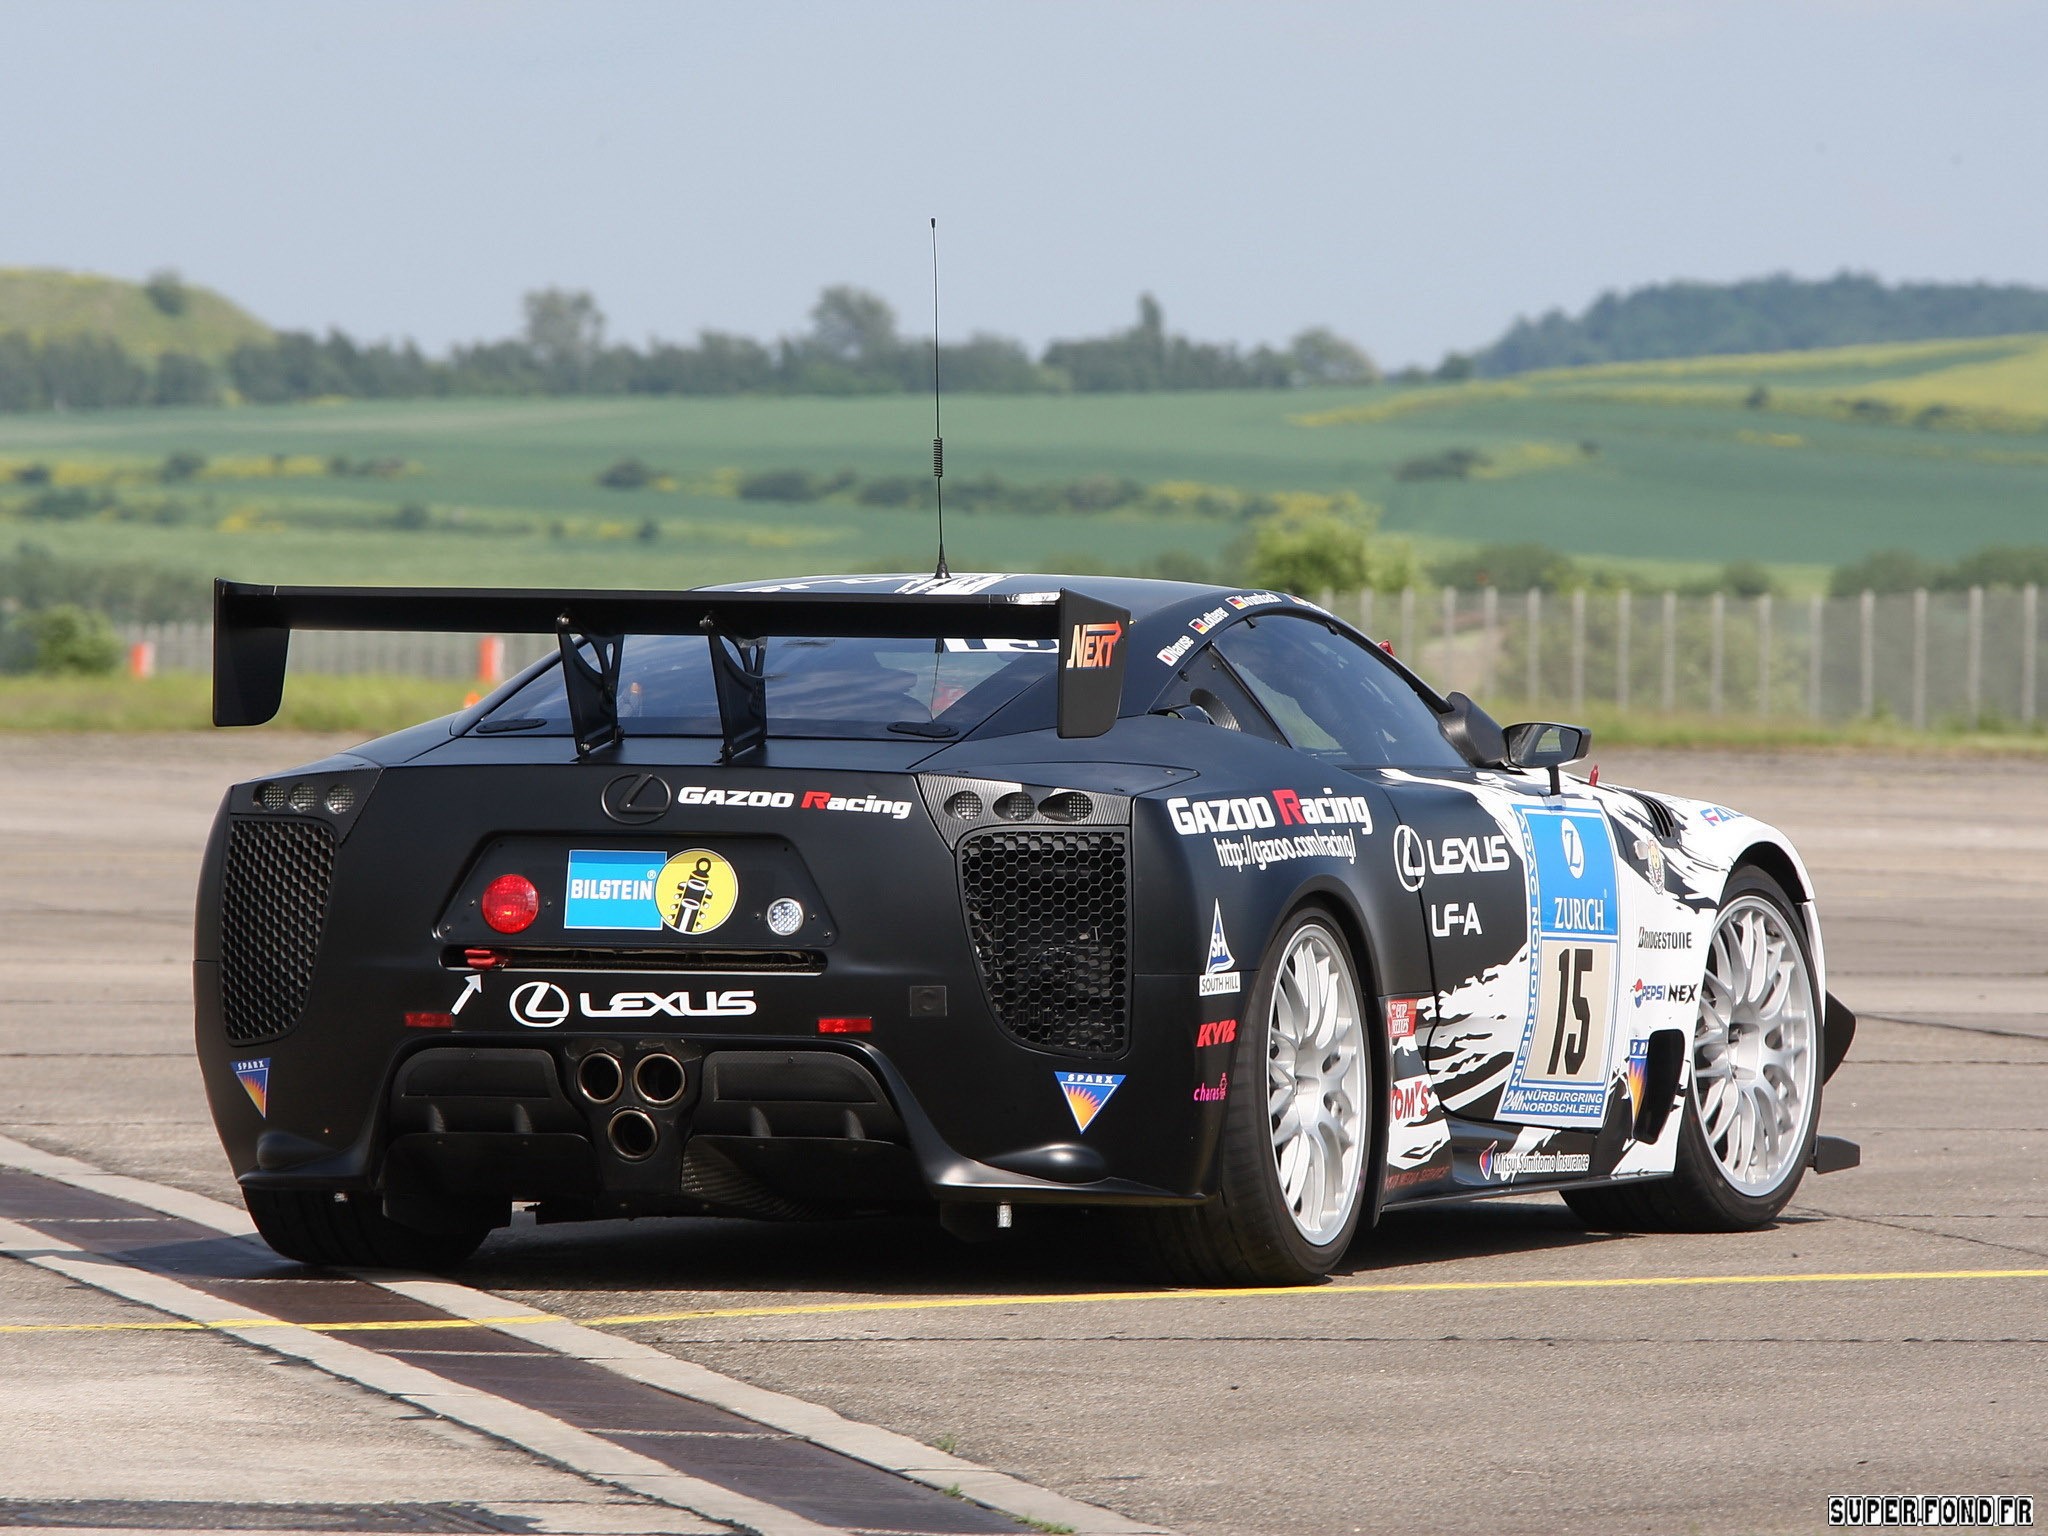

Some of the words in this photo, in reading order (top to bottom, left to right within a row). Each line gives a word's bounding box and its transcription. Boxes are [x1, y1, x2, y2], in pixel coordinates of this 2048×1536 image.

[1066, 620, 1123, 669] NEXT
[678, 786, 795, 808] GAZOO
[800, 791, 913, 820] Racing
[1166, 796, 1275, 836] GAZOO
[1272, 788, 1374, 835] Racing
[1427, 835, 1510, 876] LEXUS
[1517, 811, 1537, 894] ADAC
[571, 879, 654, 901] BILSTEIN
[1554, 897, 1604, 931] ZURICH
[1201, 977, 1223, 993] SOUTH
[1224, 975, 1239, 991] HILL
[1511, 907, 1540, 1086] NORDRHEIN
[1642, 985, 1666, 1001] PEPSI
[1668, 983, 1698, 1004] NEX
[579, 990, 757, 1017] LEXUS
[1547, 948, 1593, 1076] 15
[1197, 1019, 1237, 1047] KYB
[237, 1060, 265, 1070] SPARX
[1067, 1073, 1114, 1084] SPARX
[1519, 1102, 1602, 1115] NORDSCHLEIFE
[1524, 1089, 1604, 1104] NÜRBURGRING
[1519, 1152, 1555, 1172] Sumitomo
[1556, 1151, 1590, 1171] Insurance
